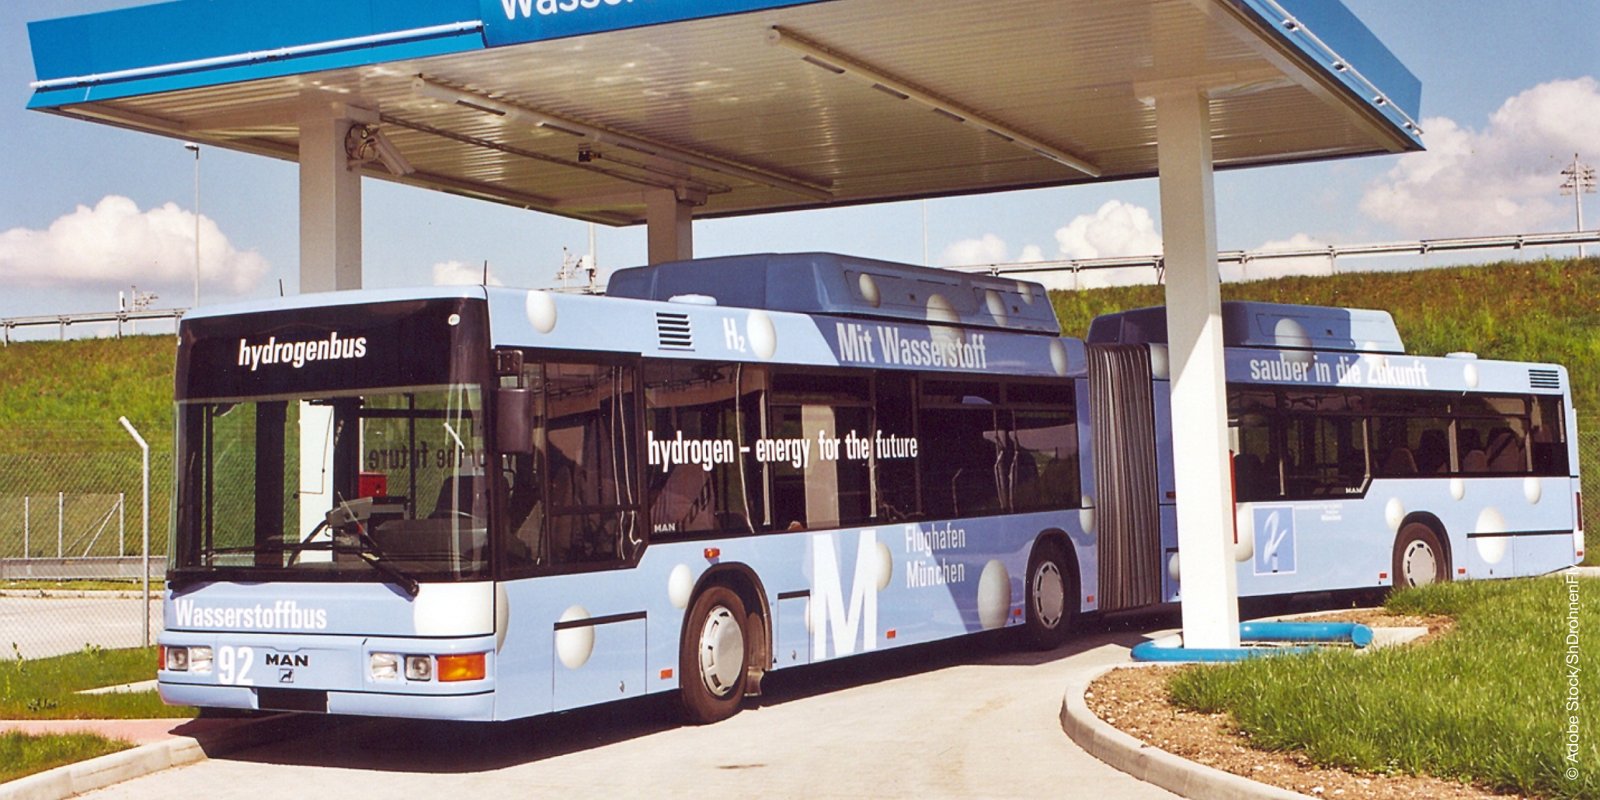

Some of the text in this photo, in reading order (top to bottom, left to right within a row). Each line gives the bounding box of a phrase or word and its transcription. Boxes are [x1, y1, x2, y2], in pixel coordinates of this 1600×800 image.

[238, 331, 367, 371] hydrogenbus
[836, 322, 988, 369] Mit Wasserstoff
[1250, 353, 1430, 386] sauber in die Zukunft
[647, 430, 735, 472] hydrogen
[756, 436, 811, 469] energy
[817, 430, 841, 461] for
[845, 430, 869, 460] the
[875, 429, 918, 459] future
[654, 523, 676, 533] MAN
[905, 522, 966, 557] Flughafen
[906, 558, 965, 588] München
[812, 529, 877, 660] M
[175, 599, 327, 630] Wasserstoffbus
[218, 645, 254, 686] 92
[265, 653, 309, 667] MAN
